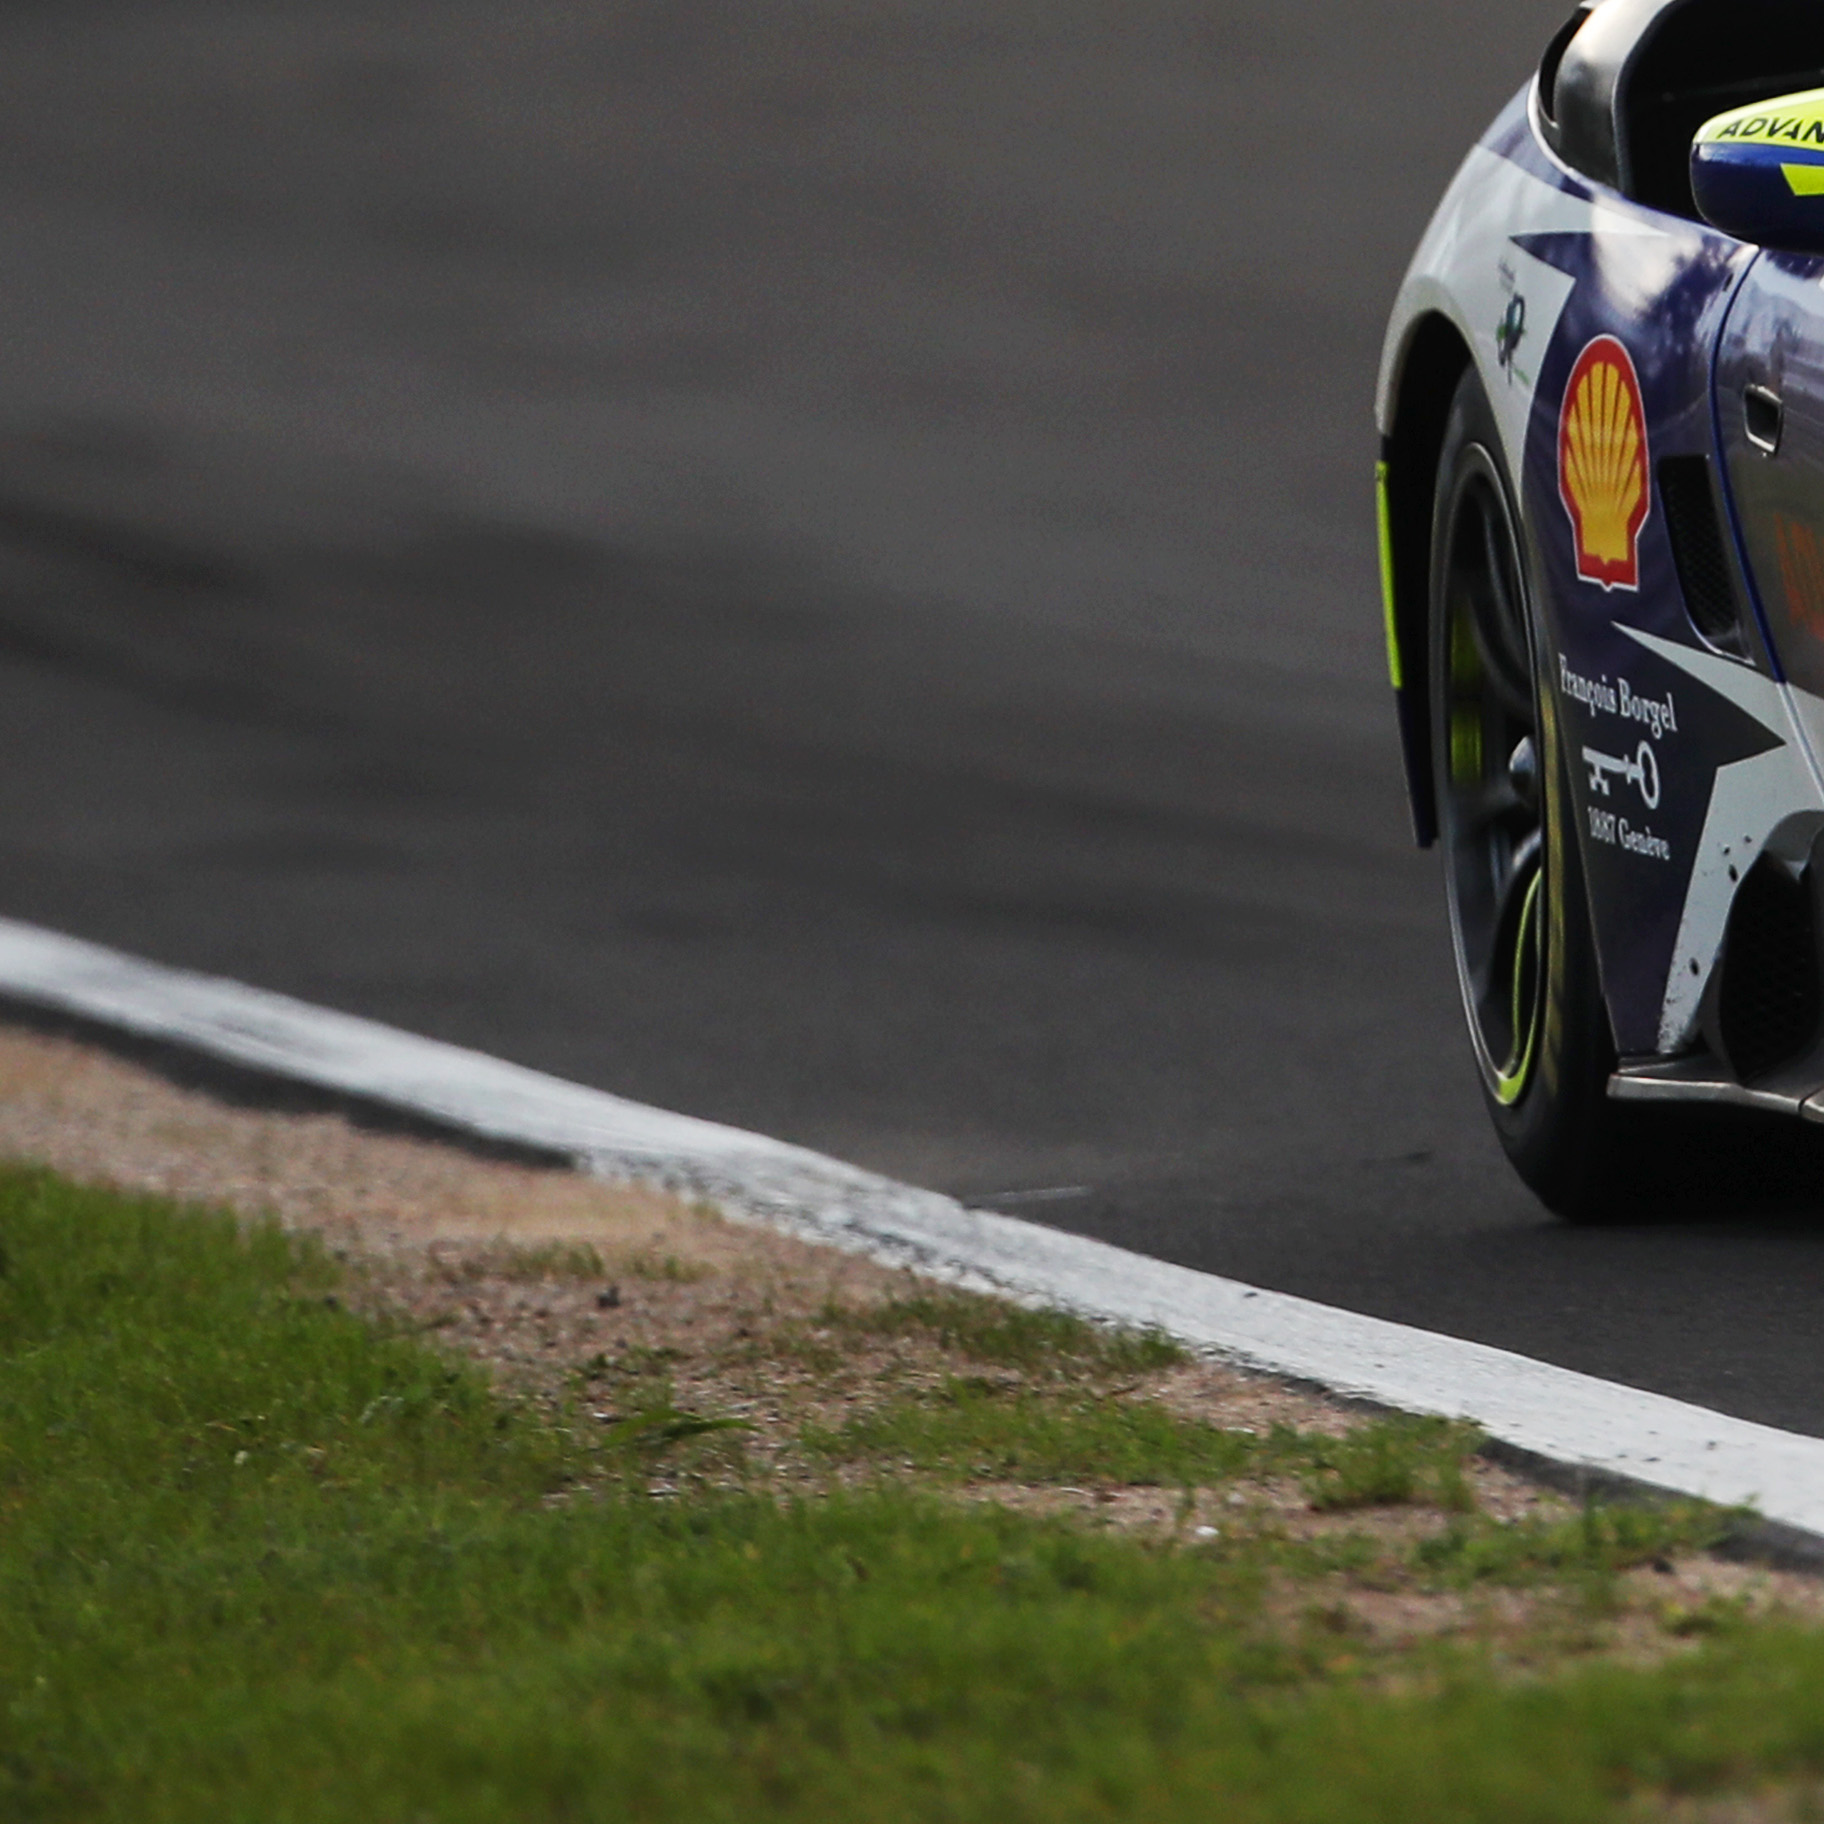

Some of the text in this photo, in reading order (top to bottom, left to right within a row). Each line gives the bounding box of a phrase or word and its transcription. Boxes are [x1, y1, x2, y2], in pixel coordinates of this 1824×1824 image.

[1558, 652, 1678, 740] François Borgel
[1618, 817, 1671, 861] Genève
